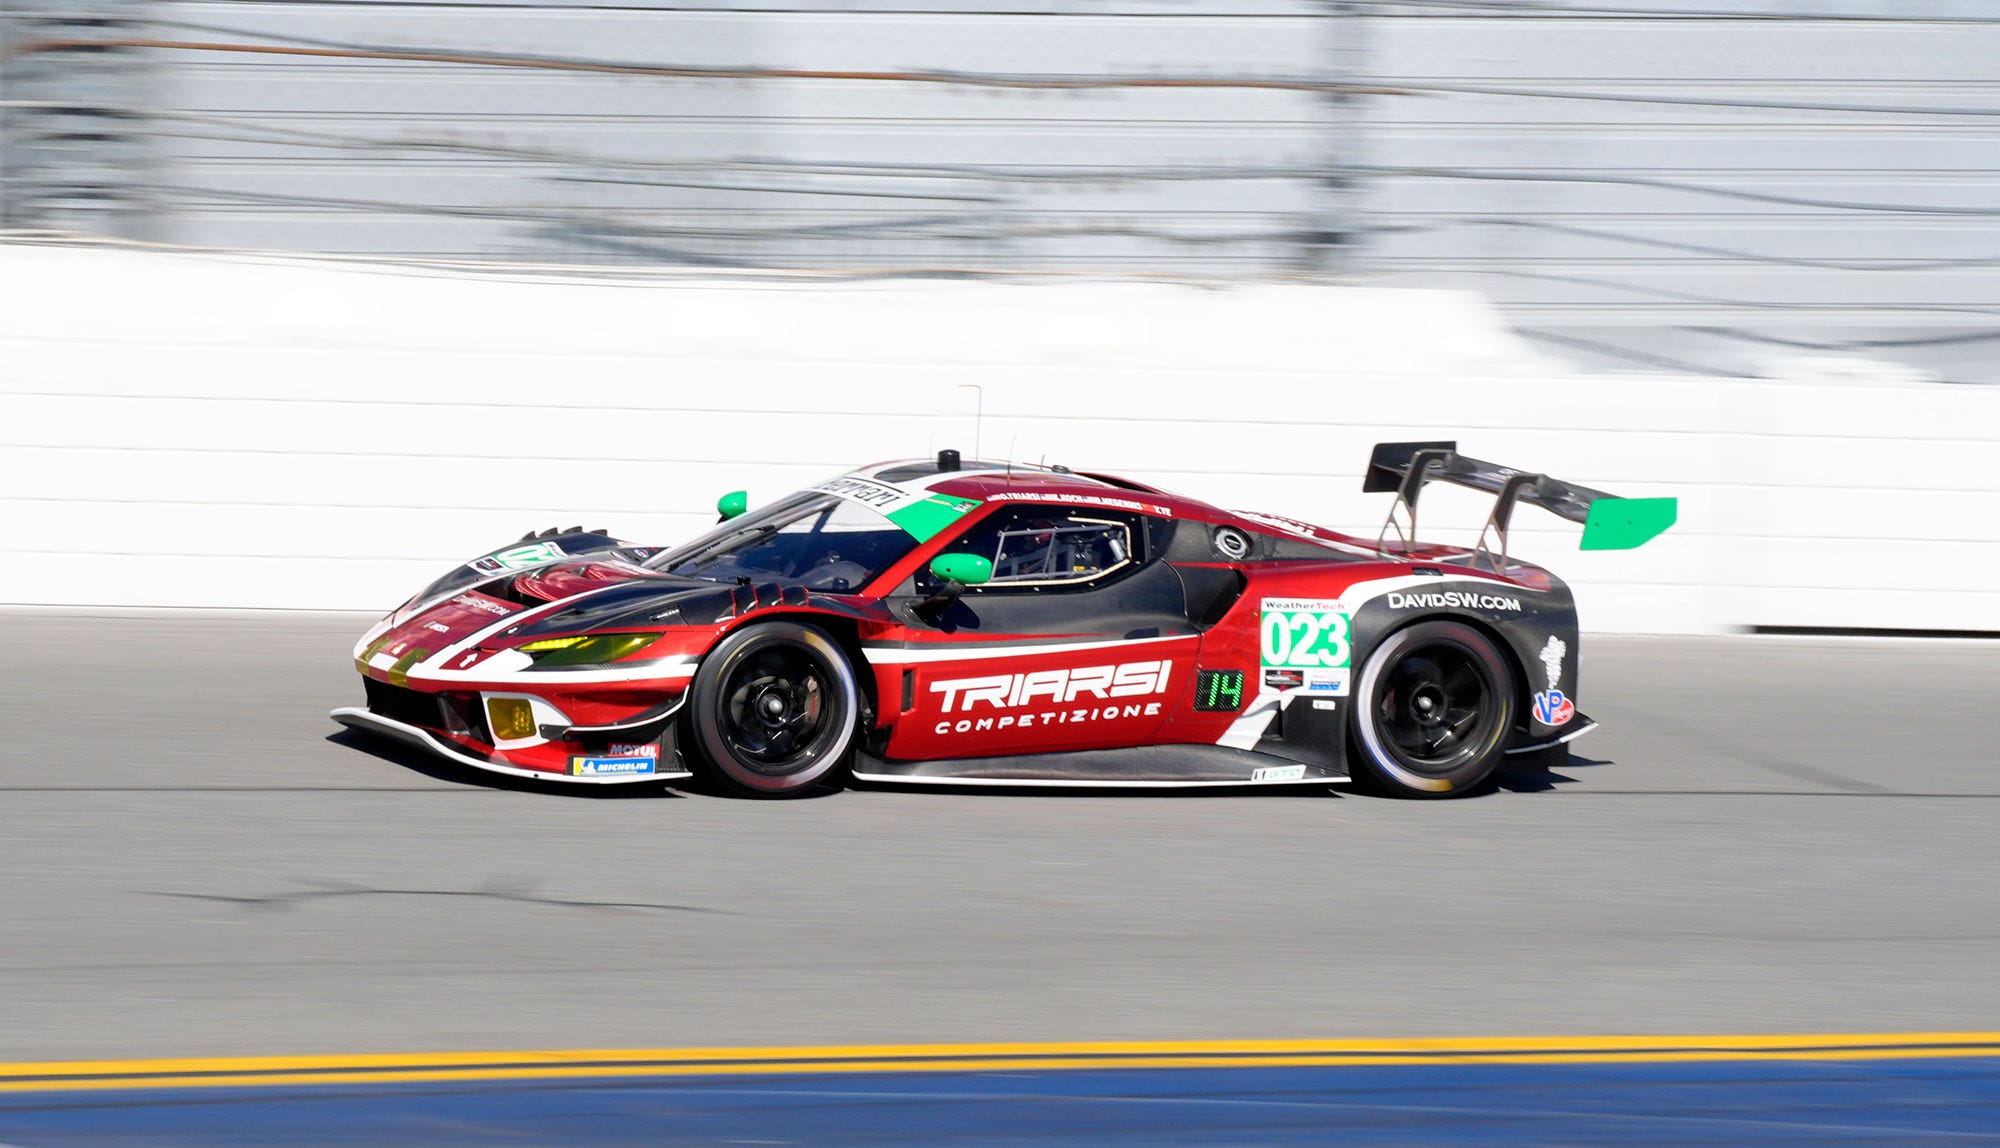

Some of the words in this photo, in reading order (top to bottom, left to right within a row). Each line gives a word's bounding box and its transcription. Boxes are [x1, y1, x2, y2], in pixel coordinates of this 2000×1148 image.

[1265, 601, 1345, 610] WeatherTech
[1387, 592, 1521, 611] DAVIDSW.COM
[1261, 611, 1350, 667] 023
[929, 660, 1172, 713] TRIARSI
[1208, 672, 1243, 707] 14
[934, 702, 1162, 735] COMPETIZIONE
[1535, 689, 1564, 724] VP
[597, 762, 648, 772] MICHELIN
[609, 744, 657, 758] MOTUL
